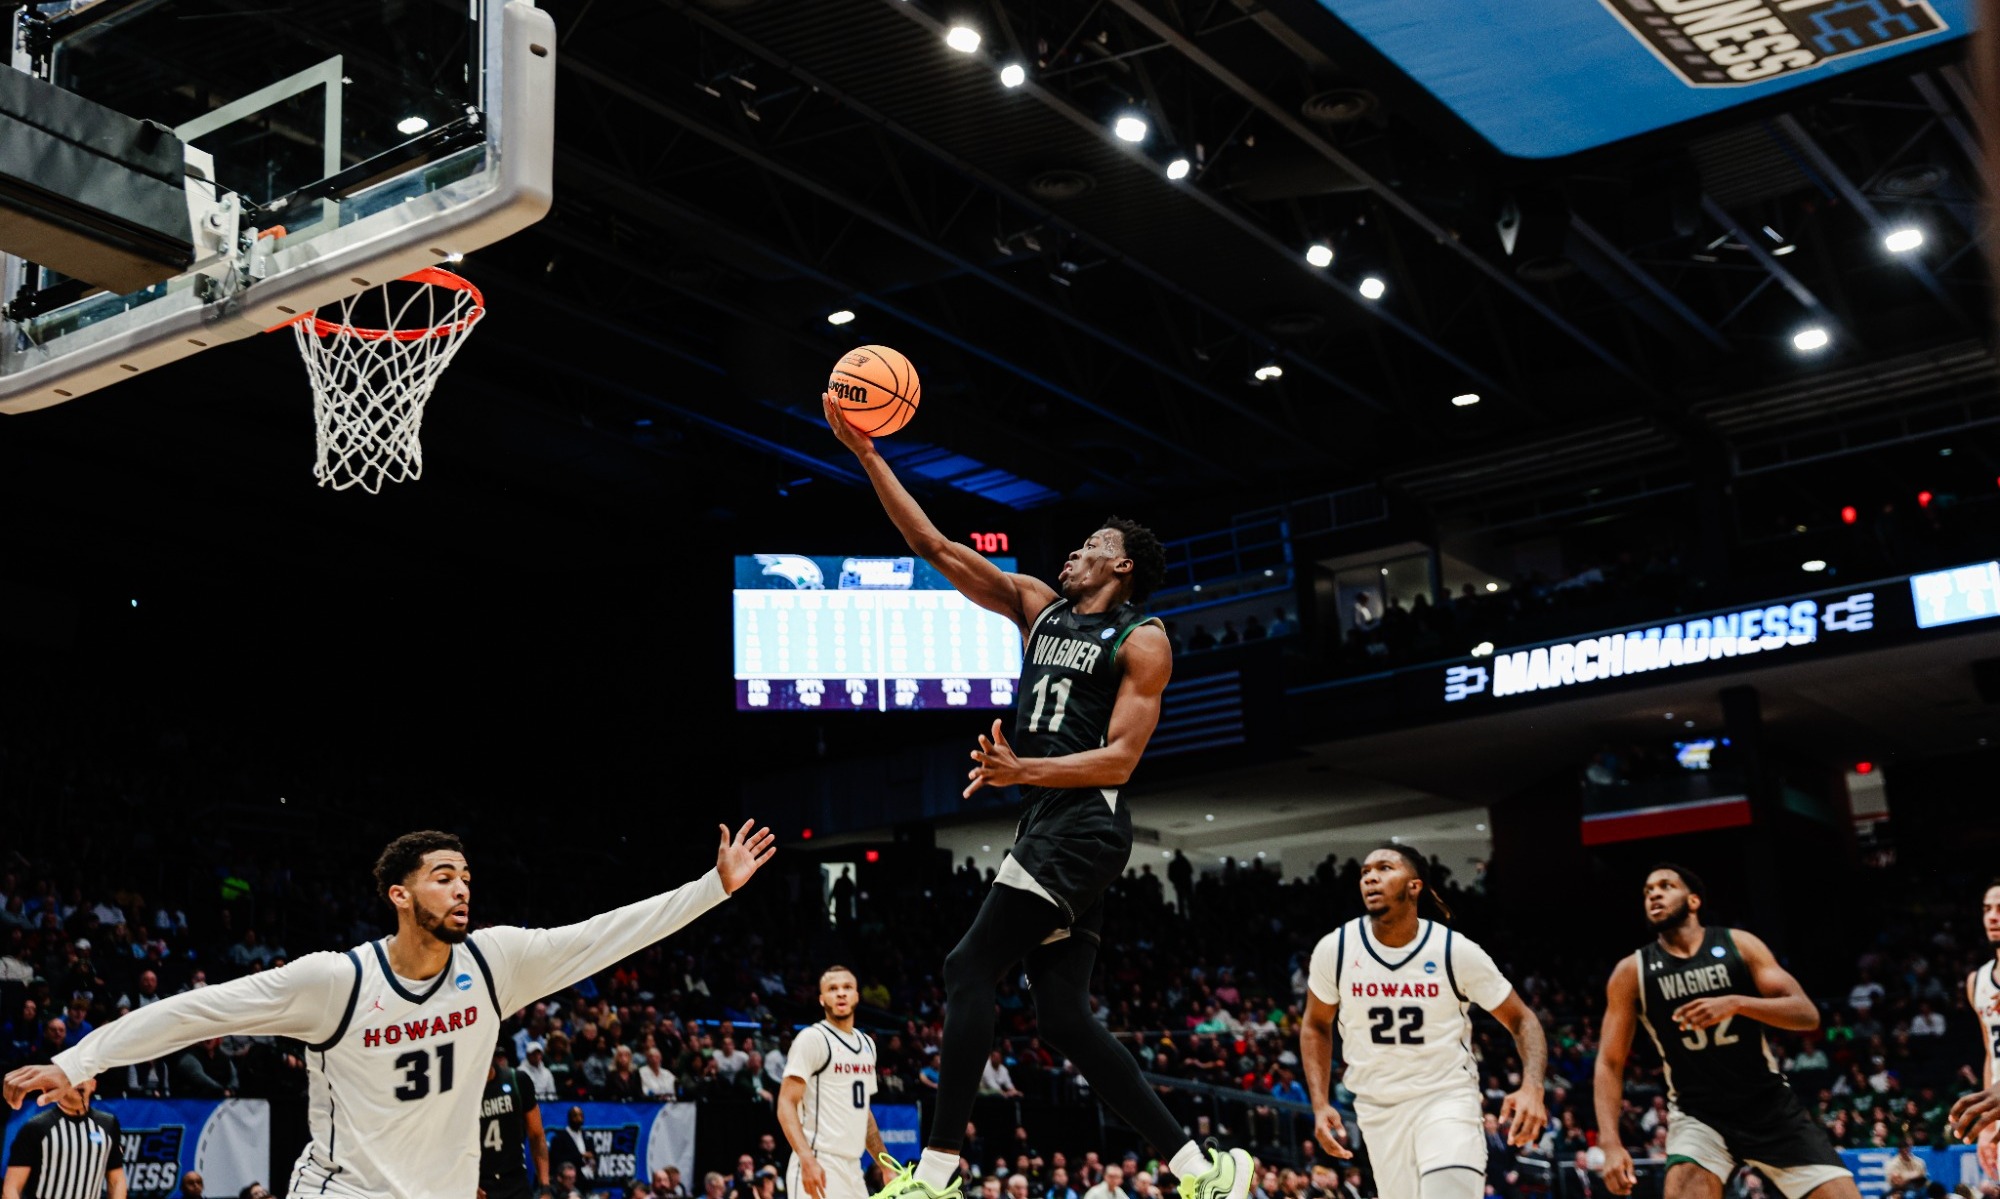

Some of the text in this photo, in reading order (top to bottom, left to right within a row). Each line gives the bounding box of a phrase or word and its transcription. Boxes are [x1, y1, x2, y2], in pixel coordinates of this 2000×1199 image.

[1032, 634, 1102, 674] WAGNER
[1028, 674, 1073, 732] 11
[1352, 982, 1439, 998] HOWARD
[1658, 963, 1732, 1000] WAGNER
[363, 1006, 478, 1048] HOWARD
[1368, 1006, 1425, 1045] 22
[394, 1042, 454, 1102] 31
[853, 1080, 865, 1109] 0
[484, 1119, 503, 1152] 4
